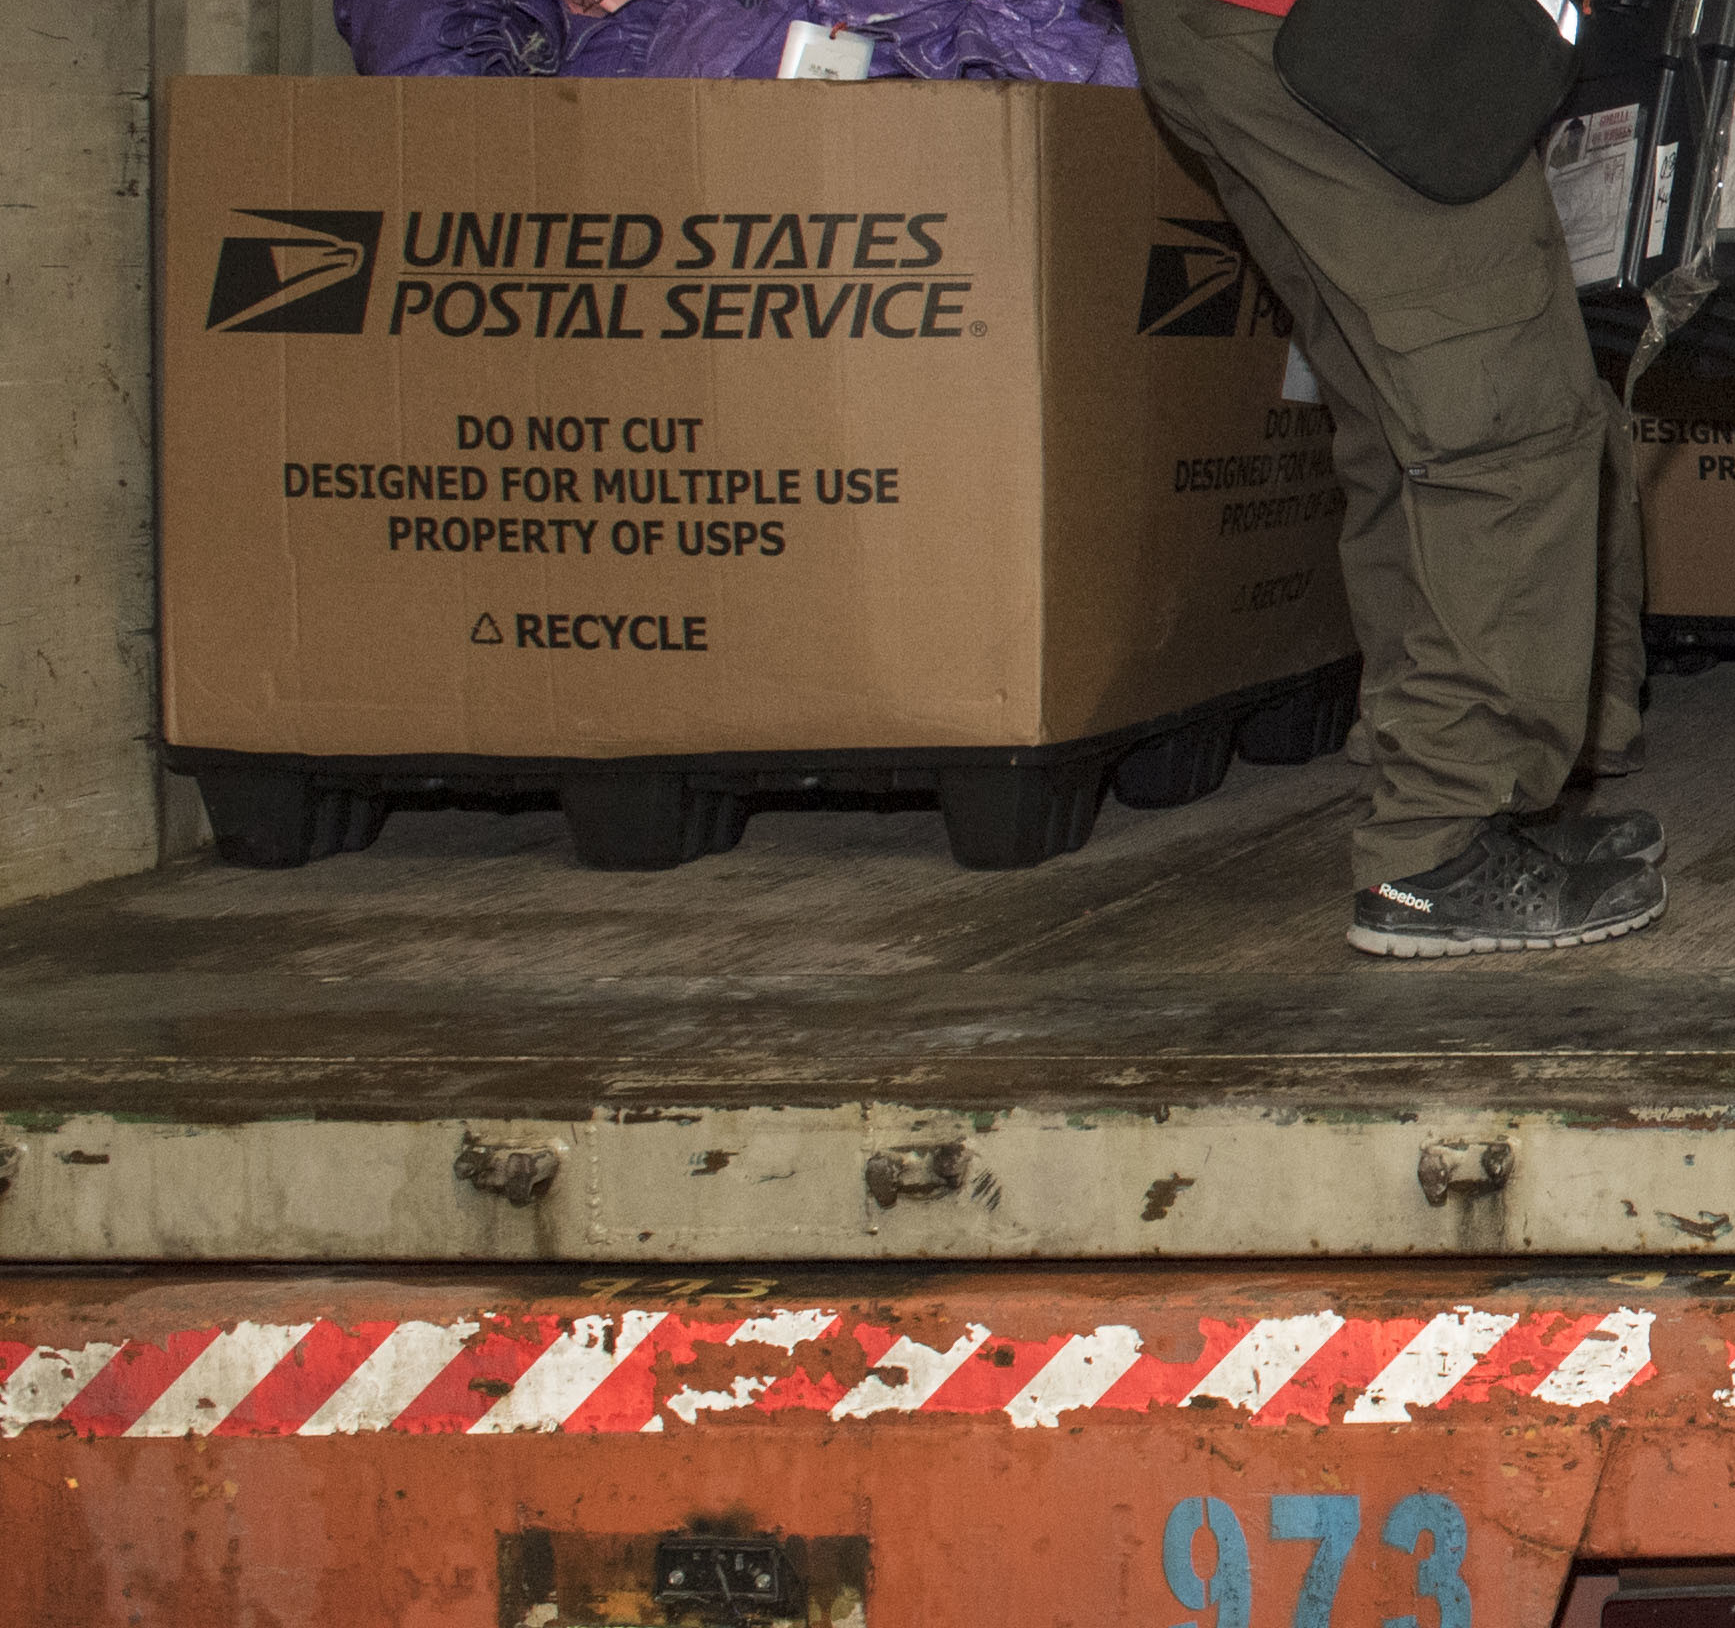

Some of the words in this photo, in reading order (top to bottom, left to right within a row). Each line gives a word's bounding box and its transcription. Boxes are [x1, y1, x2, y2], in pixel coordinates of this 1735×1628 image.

[403, 211, 664, 270] UNITED
[675, 213, 948, 270] STATES
[389, 280, 644, 339] POSTAL
[456, 414, 514, 451] DO
[526, 416, 610, 453] NOT
[621, 417, 704, 454] CUT
[1264, 407, 1292, 440] DO
[283, 462, 489, 502] DESIGNED
[501, 466, 582, 504] FOR
[593, 468, 802, 505] MULTIPLE
[815, 467, 900, 505] USE
[1174, 454, 1272, 493] DESIGNED
[1218, 495, 1301, 536] PROPERTY
[388, 516, 599, 555] PROPERTY
[610, 520, 665, 556] OF
[677, 520, 786, 557] USPS
[515, 612, 708, 652] RECYCLE
[1379, 882, 1434, 913] Reebok
[1162, 1493, 1473, 1628] 973
